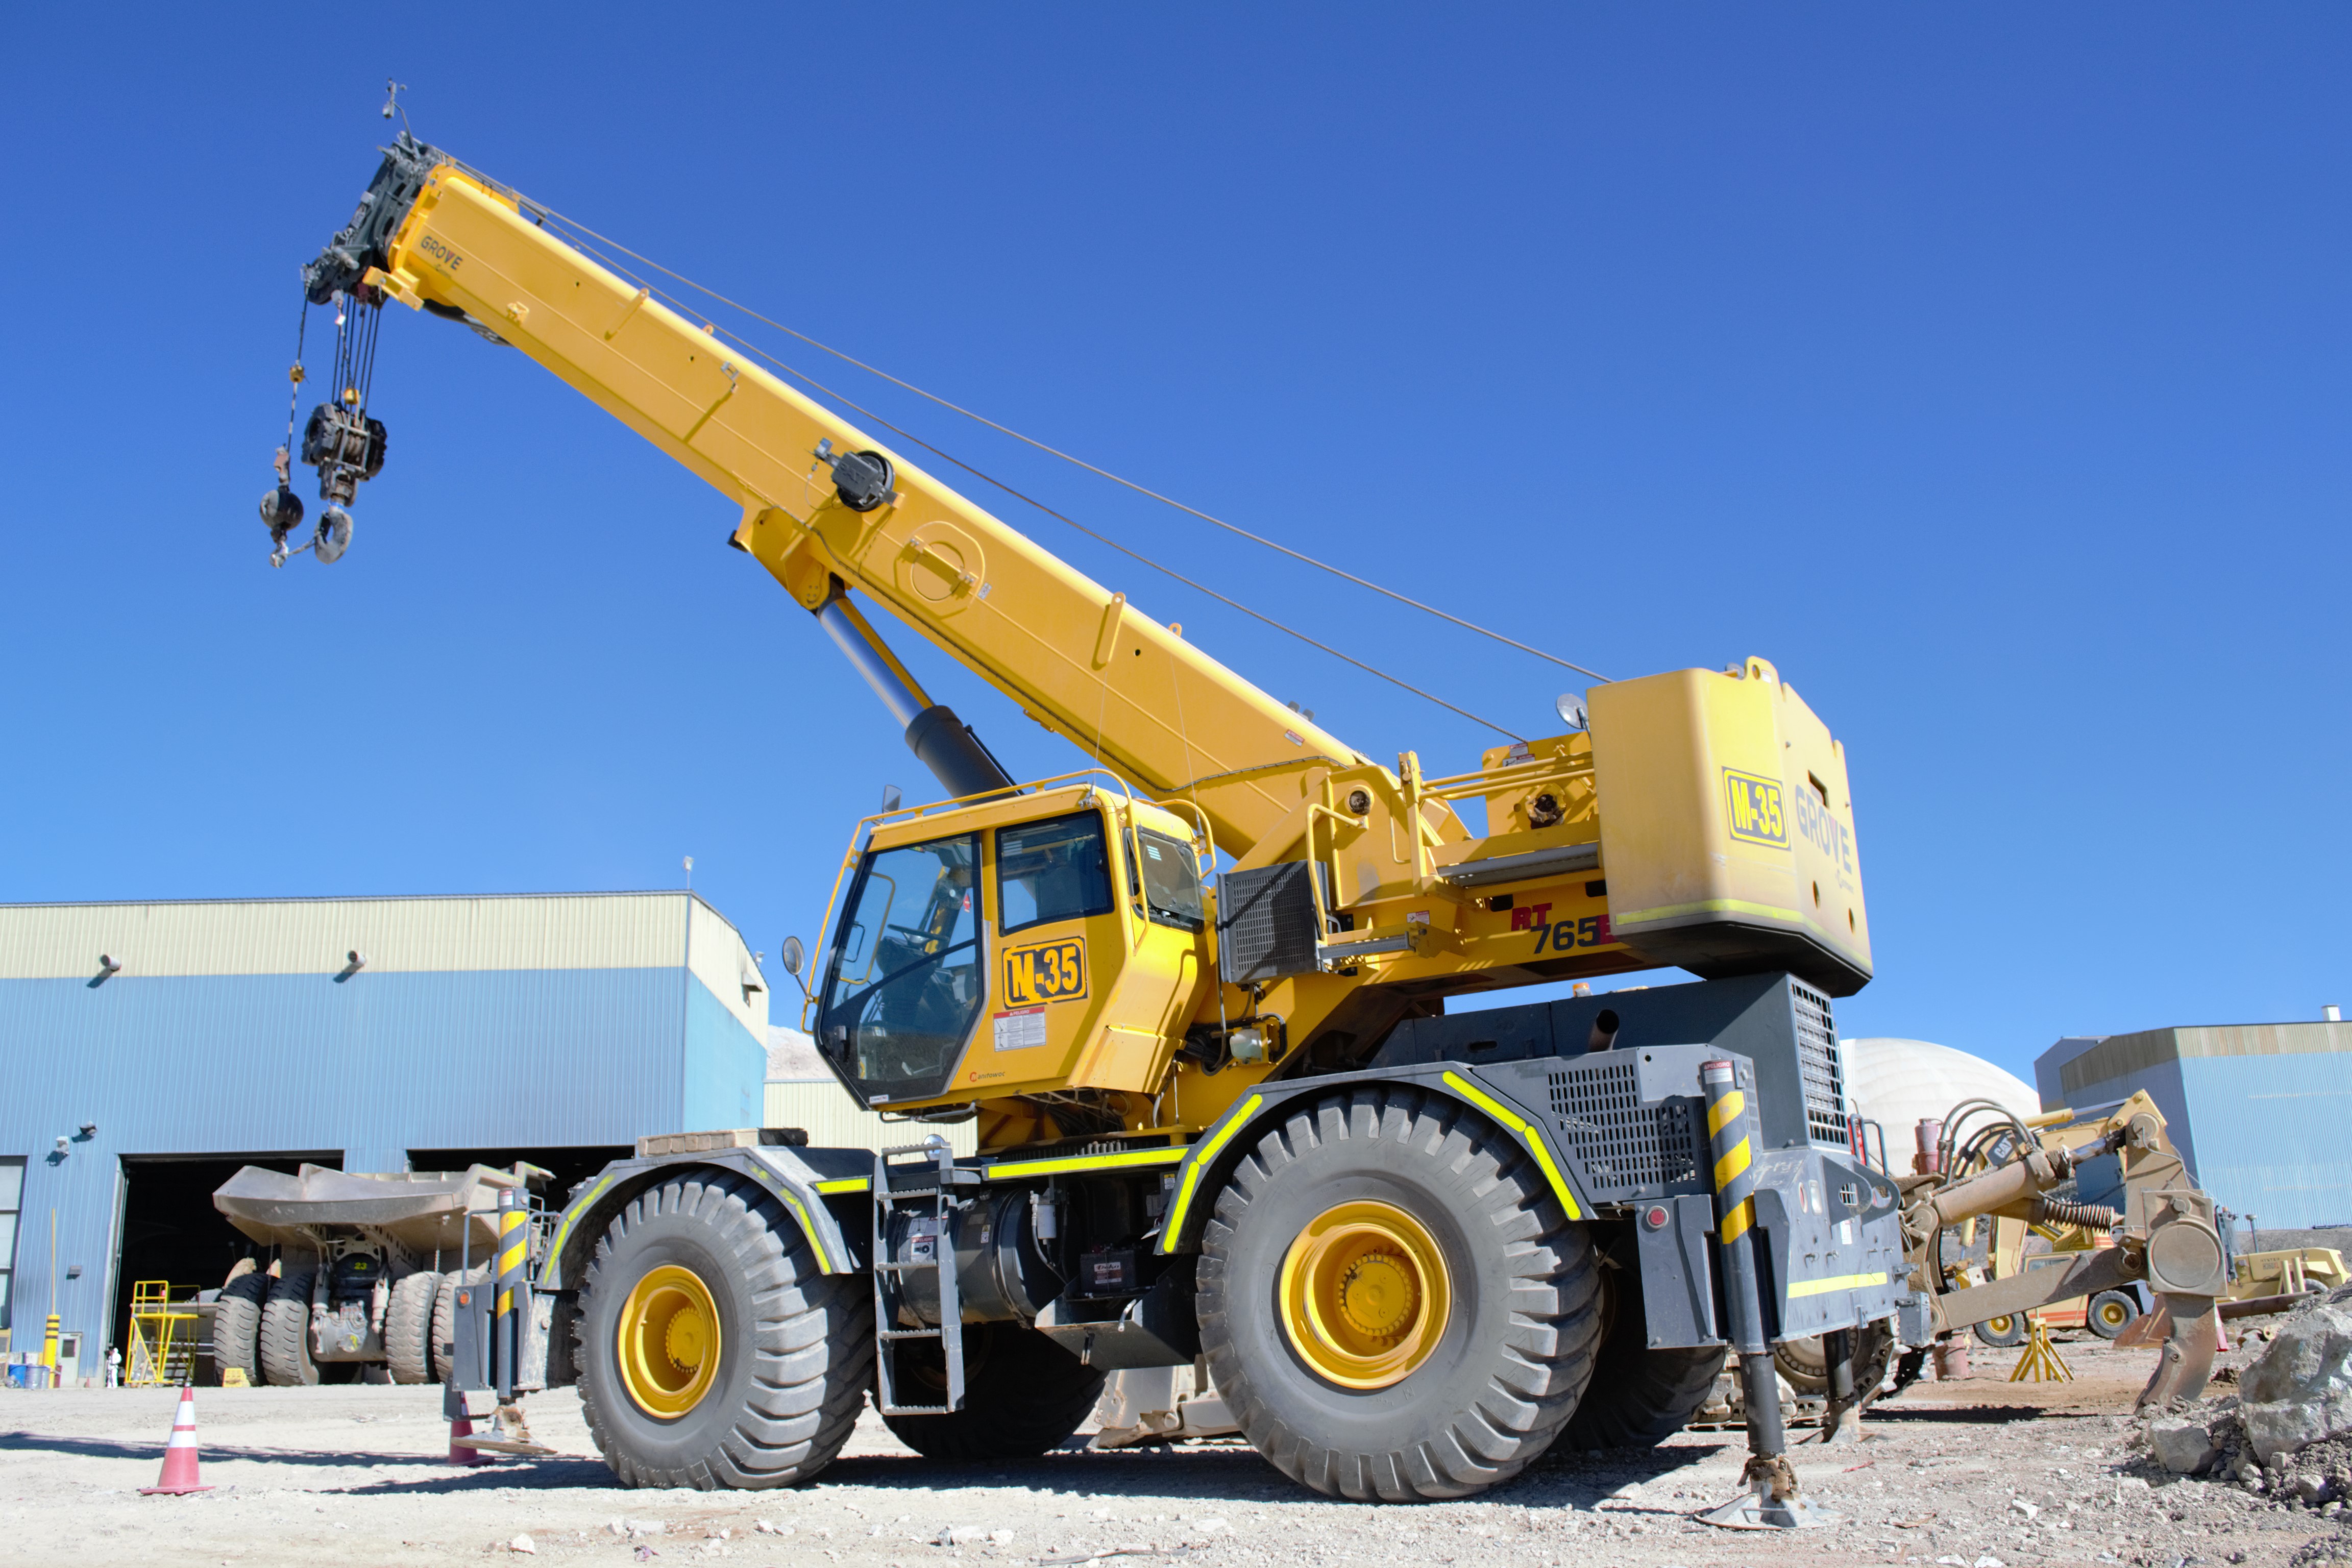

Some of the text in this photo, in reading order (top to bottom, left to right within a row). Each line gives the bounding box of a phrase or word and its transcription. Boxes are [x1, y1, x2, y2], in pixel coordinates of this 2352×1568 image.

[421, 235, 463, 271] GROVE
[1731, 779, 1782, 838] M-35
[1795, 783, 1852, 875] GROVE
[1511, 902, 1553, 932] RT
[1011, 946, 1078, 998] M-35
[969, 1071, 1006, 1083] Manitowoc
[1994, 1137, 2013, 1159] CAT
[354, 1262, 368, 1270] 23
